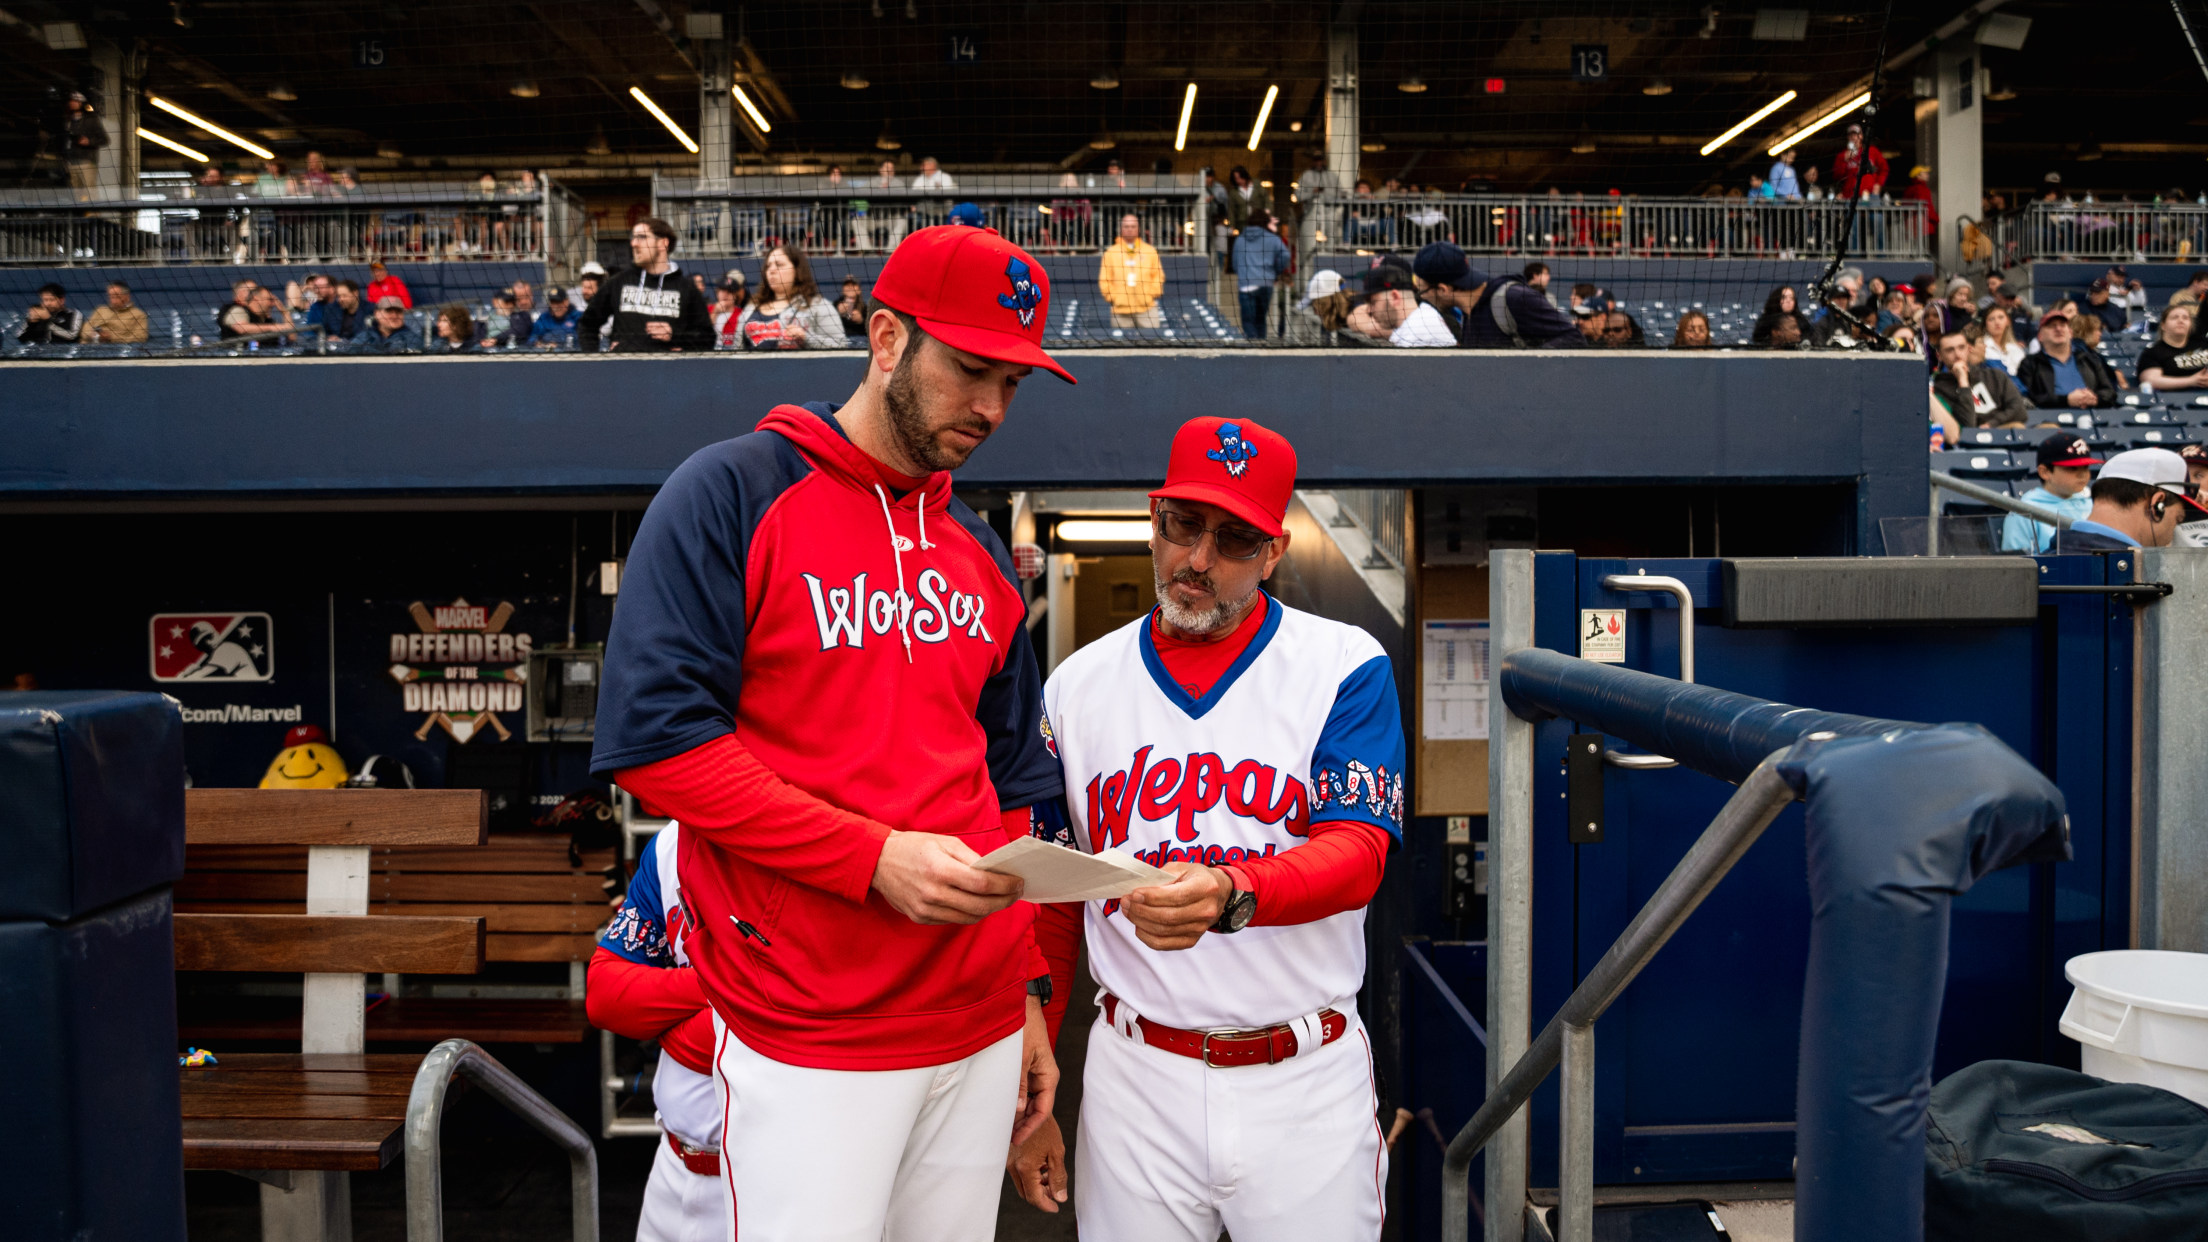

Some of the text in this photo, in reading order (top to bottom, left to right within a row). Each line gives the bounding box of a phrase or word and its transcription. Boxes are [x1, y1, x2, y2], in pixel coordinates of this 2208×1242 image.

[359, 40, 384, 65] 15
[951, 36, 977, 61] 14
[1579, 51, 1603, 77] 13
[435, 607, 487, 628] MARVEL
[800, 567, 994, 652] WooSox
[390, 632, 533, 662] DEFENDERS
[444, 667, 479, 679] OF THE
[404, 682, 523, 712] DIAMOND
[296, 727, 308, 736] W
[1086, 744, 1310, 856] Wepas
